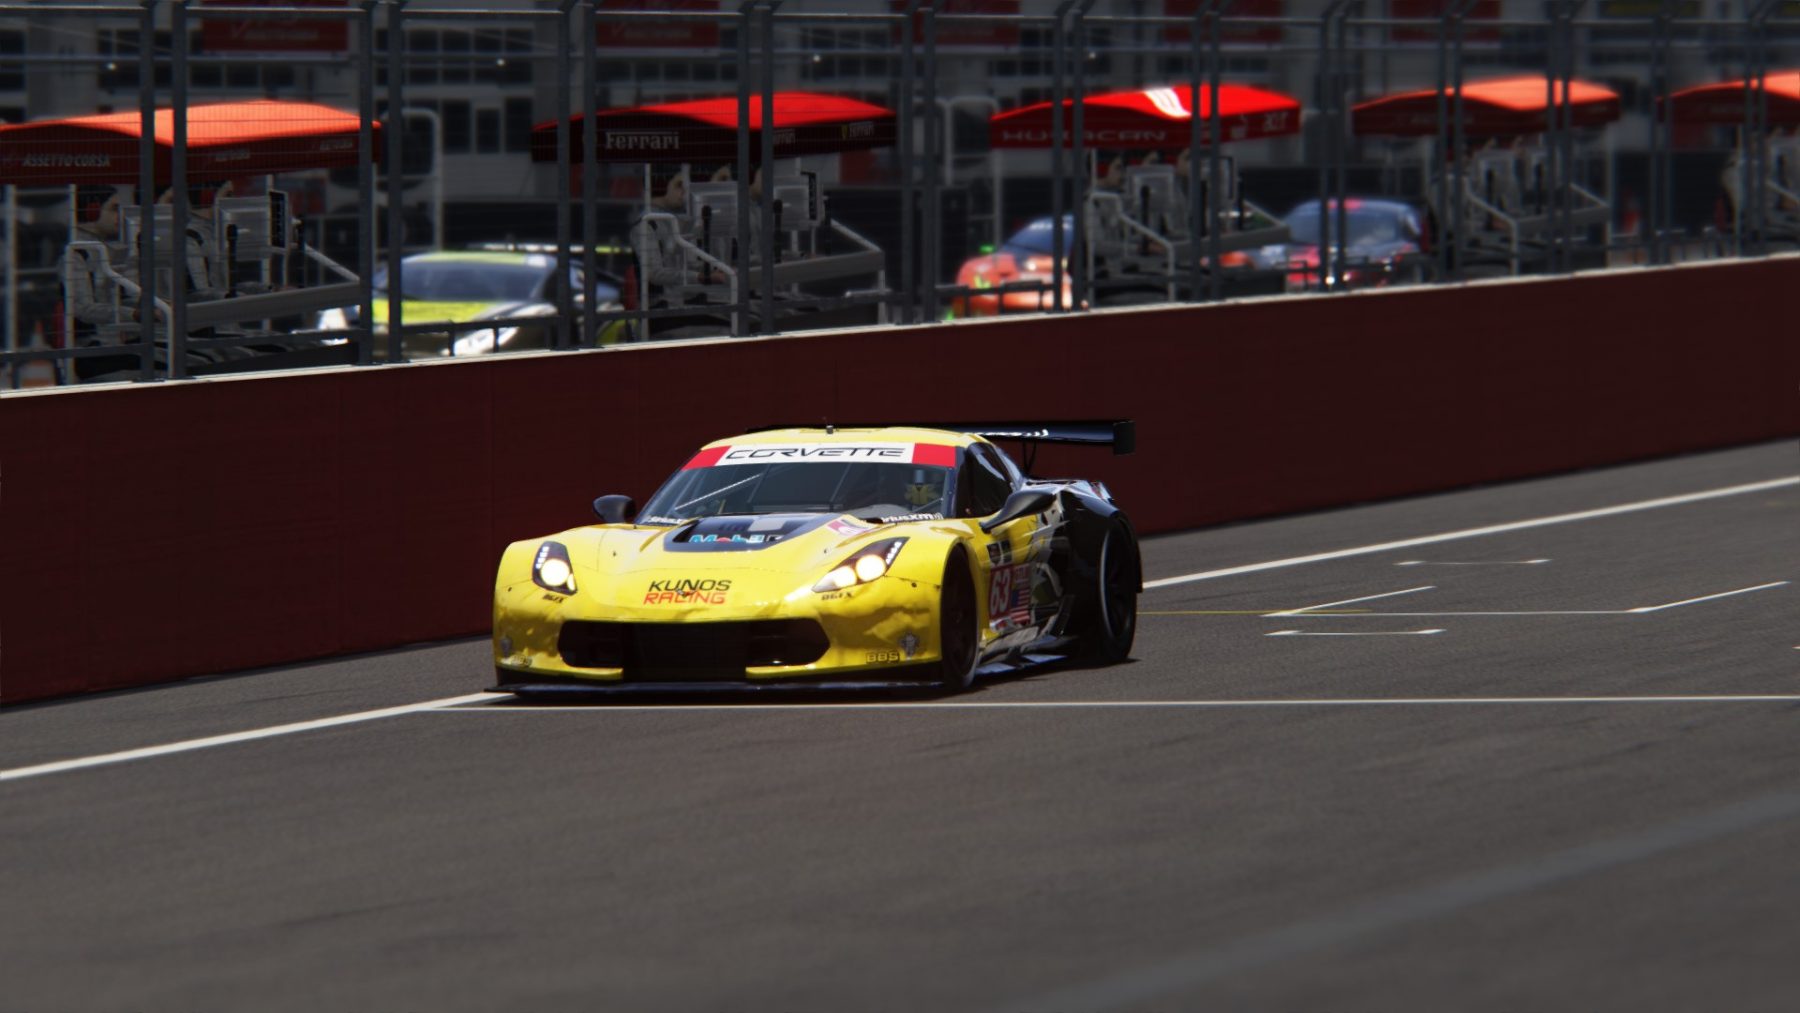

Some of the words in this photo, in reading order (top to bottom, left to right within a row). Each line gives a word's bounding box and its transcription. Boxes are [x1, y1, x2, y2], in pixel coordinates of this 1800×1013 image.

[606, 131, 680, 150] Ferrari
[23, 153, 73, 167] ASSETTO
[75, 153, 111, 167] CORSA
[725, 447, 906, 460] CORVETTE
[648, 579, 732, 592] KUNOS
[990, 568, 1011, 616] 63
[643, 591, 727, 605] RACING
[866, 651, 899, 663] BBS
